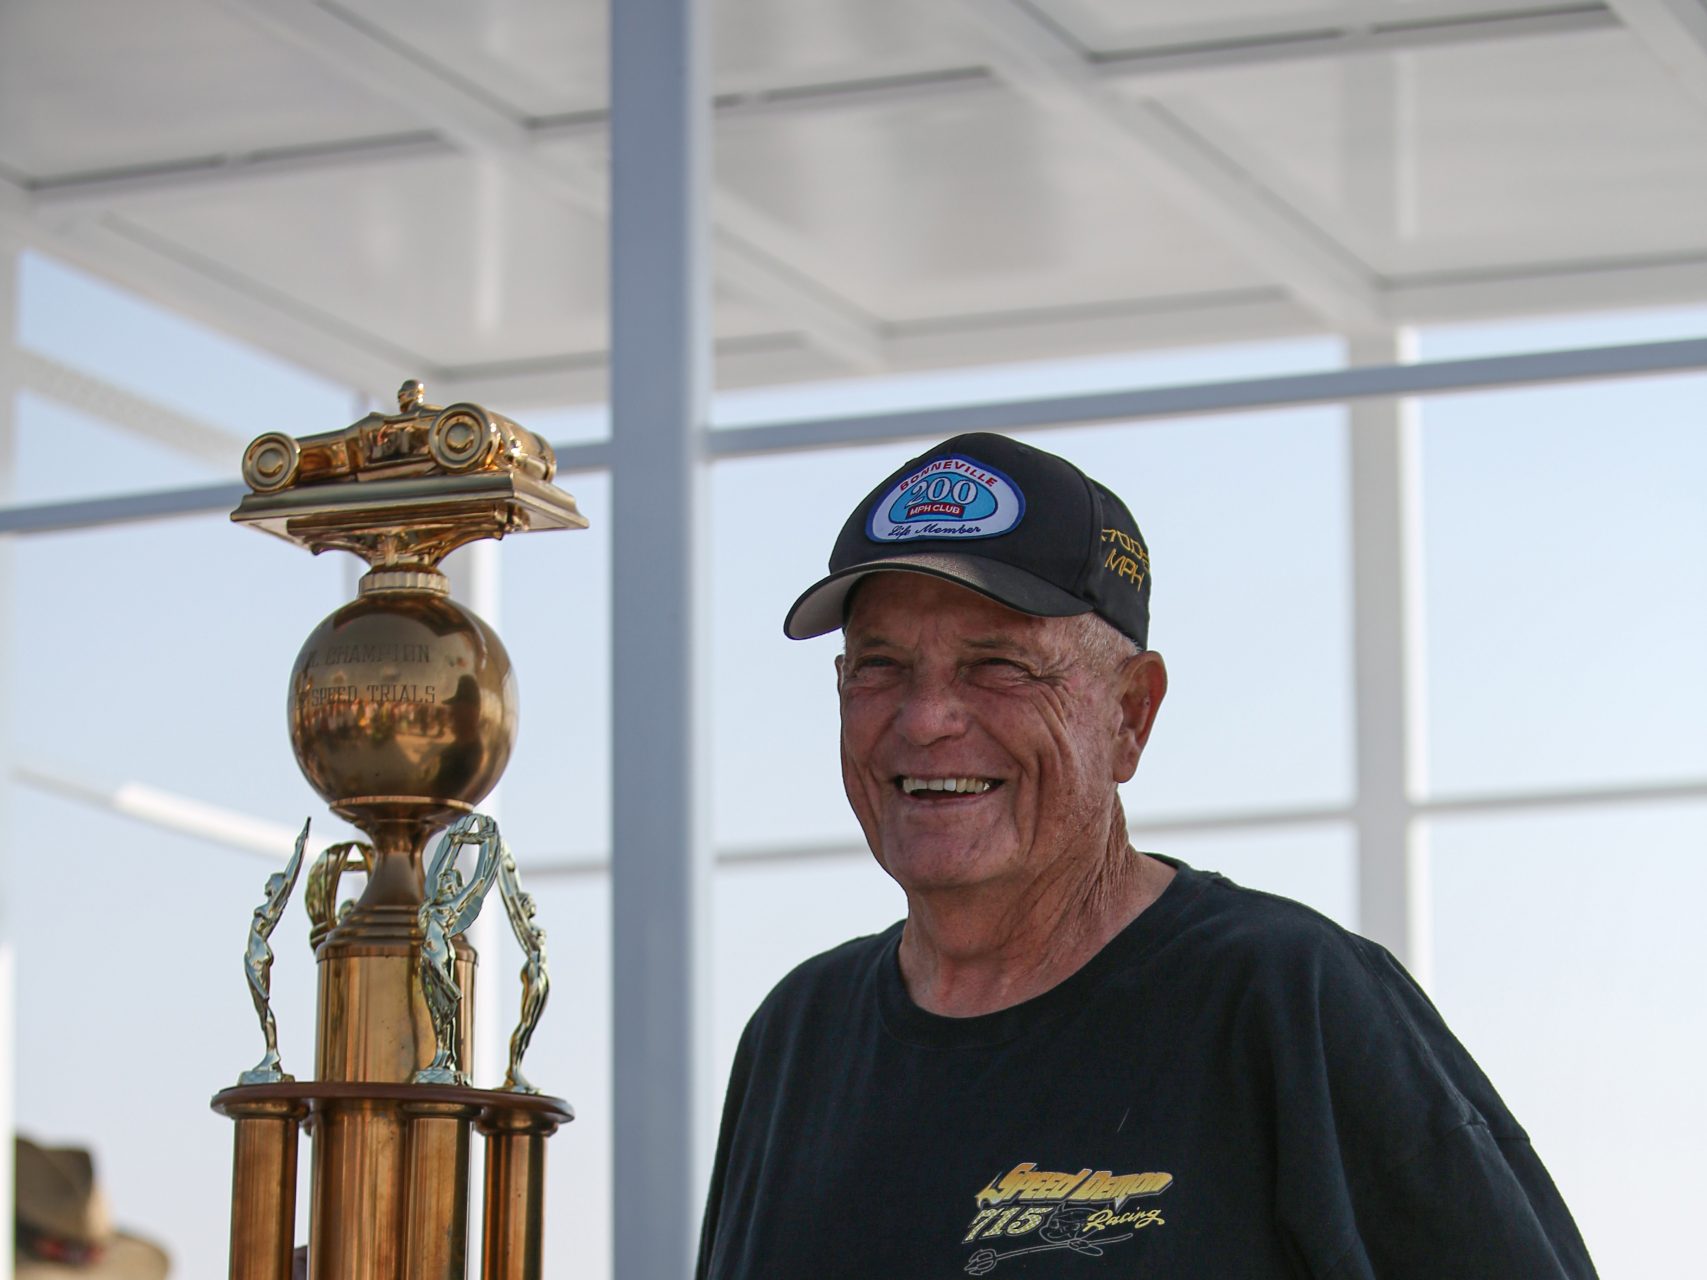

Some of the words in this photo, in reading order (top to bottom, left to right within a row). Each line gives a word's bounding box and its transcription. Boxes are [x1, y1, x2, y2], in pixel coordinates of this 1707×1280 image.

[900, 460, 998, 491] BONNEVILLE
[904, 476, 978, 509] 200
[909, 505, 931, 516] MPH
[932, 504, 960, 514] CLUB
[915, 523, 981, 535] Member
[1104, 548, 1145, 592] MPH
[311, 685, 358, 707] SPEED
[366, 684, 436, 704] TRIALS
[961, 1206, 1053, 1244] 715
[1082, 1206, 1165, 1232] Racing
